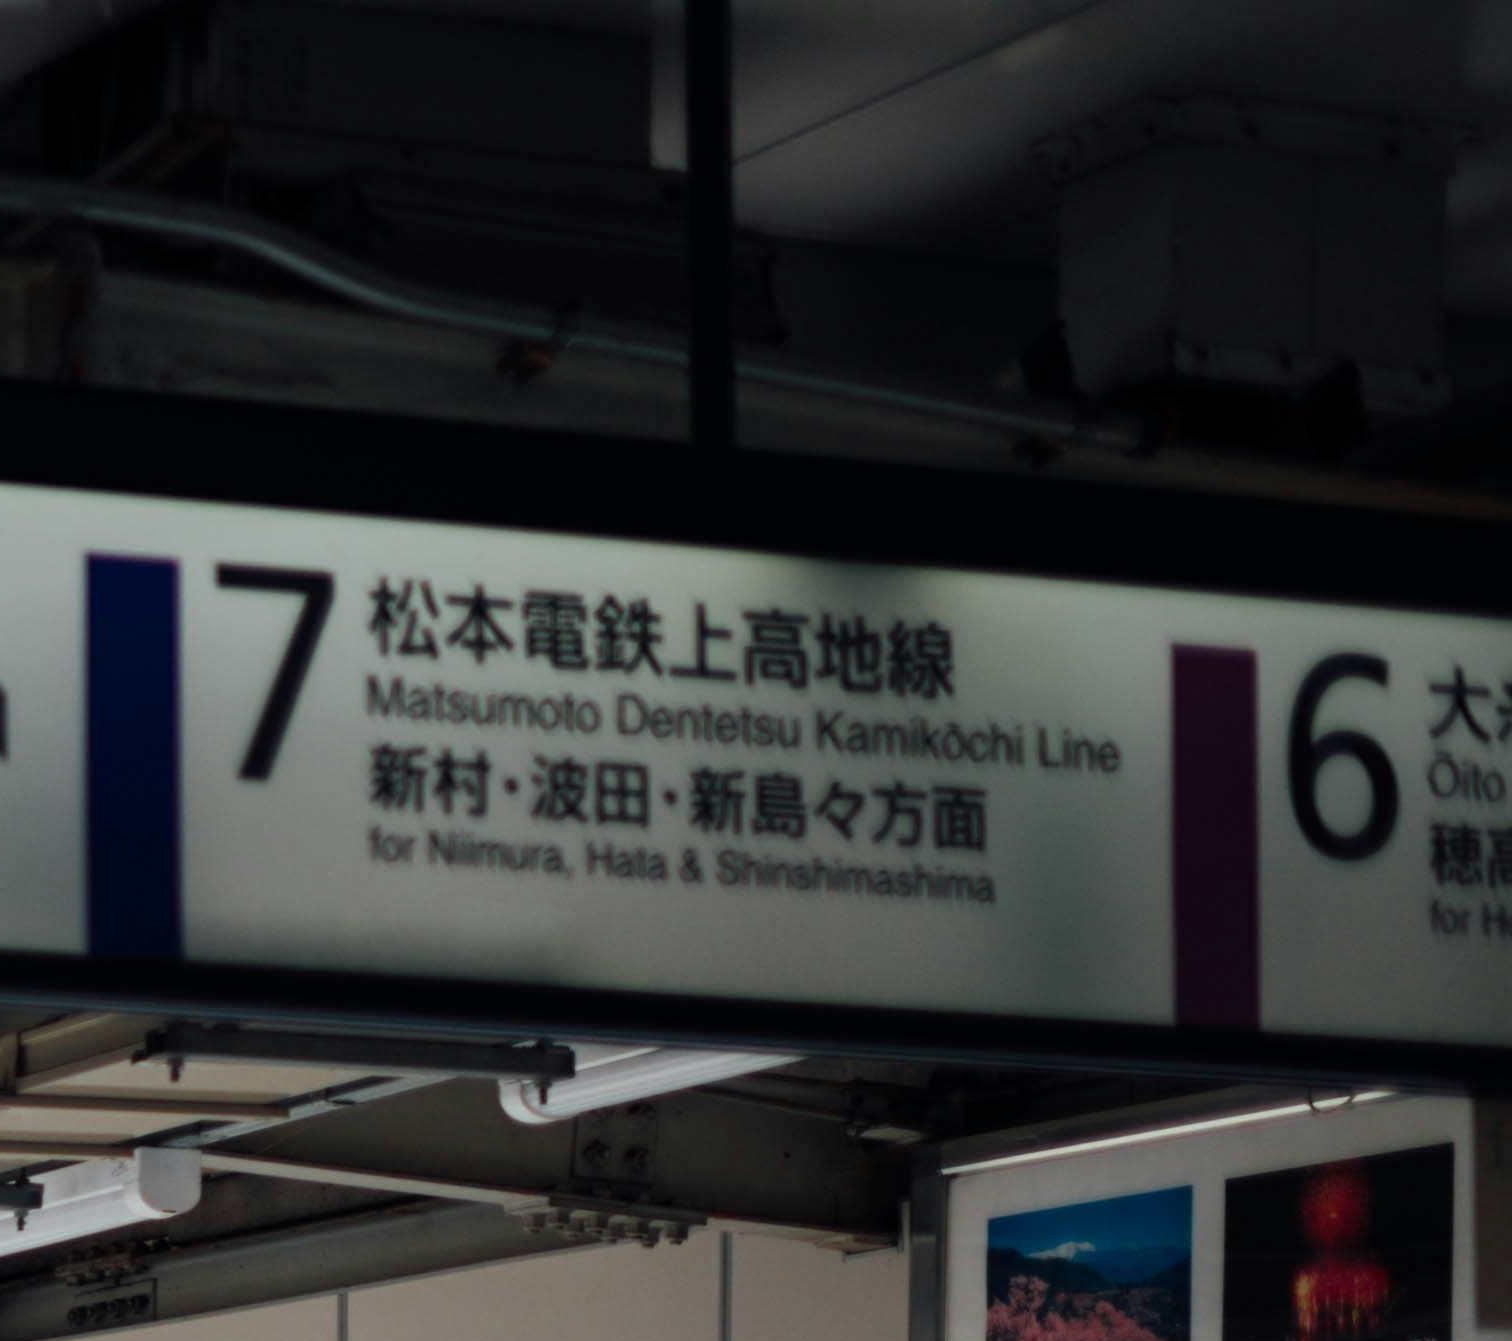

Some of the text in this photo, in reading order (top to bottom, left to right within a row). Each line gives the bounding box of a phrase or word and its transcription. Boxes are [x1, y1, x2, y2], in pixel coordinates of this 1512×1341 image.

[212, 560, 337, 784] 7
[364, 574, 957, 702] 松本電鉄上高地線
[364, 674, 604, 738] Matsumoto
[616, 698, 804, 756] Dentetsu
[1037, 728, 1123, 778] Line
[1287, 650, 1400, 862] 6
[368, 742, 990, 858] 新村・波田・新島々方面
[369, 824, 418, 866] for
[585, 840, 671, 886] Hata
[679, 850, 705, 890] &
[714, 848, 997, 910] Shinshimashima
